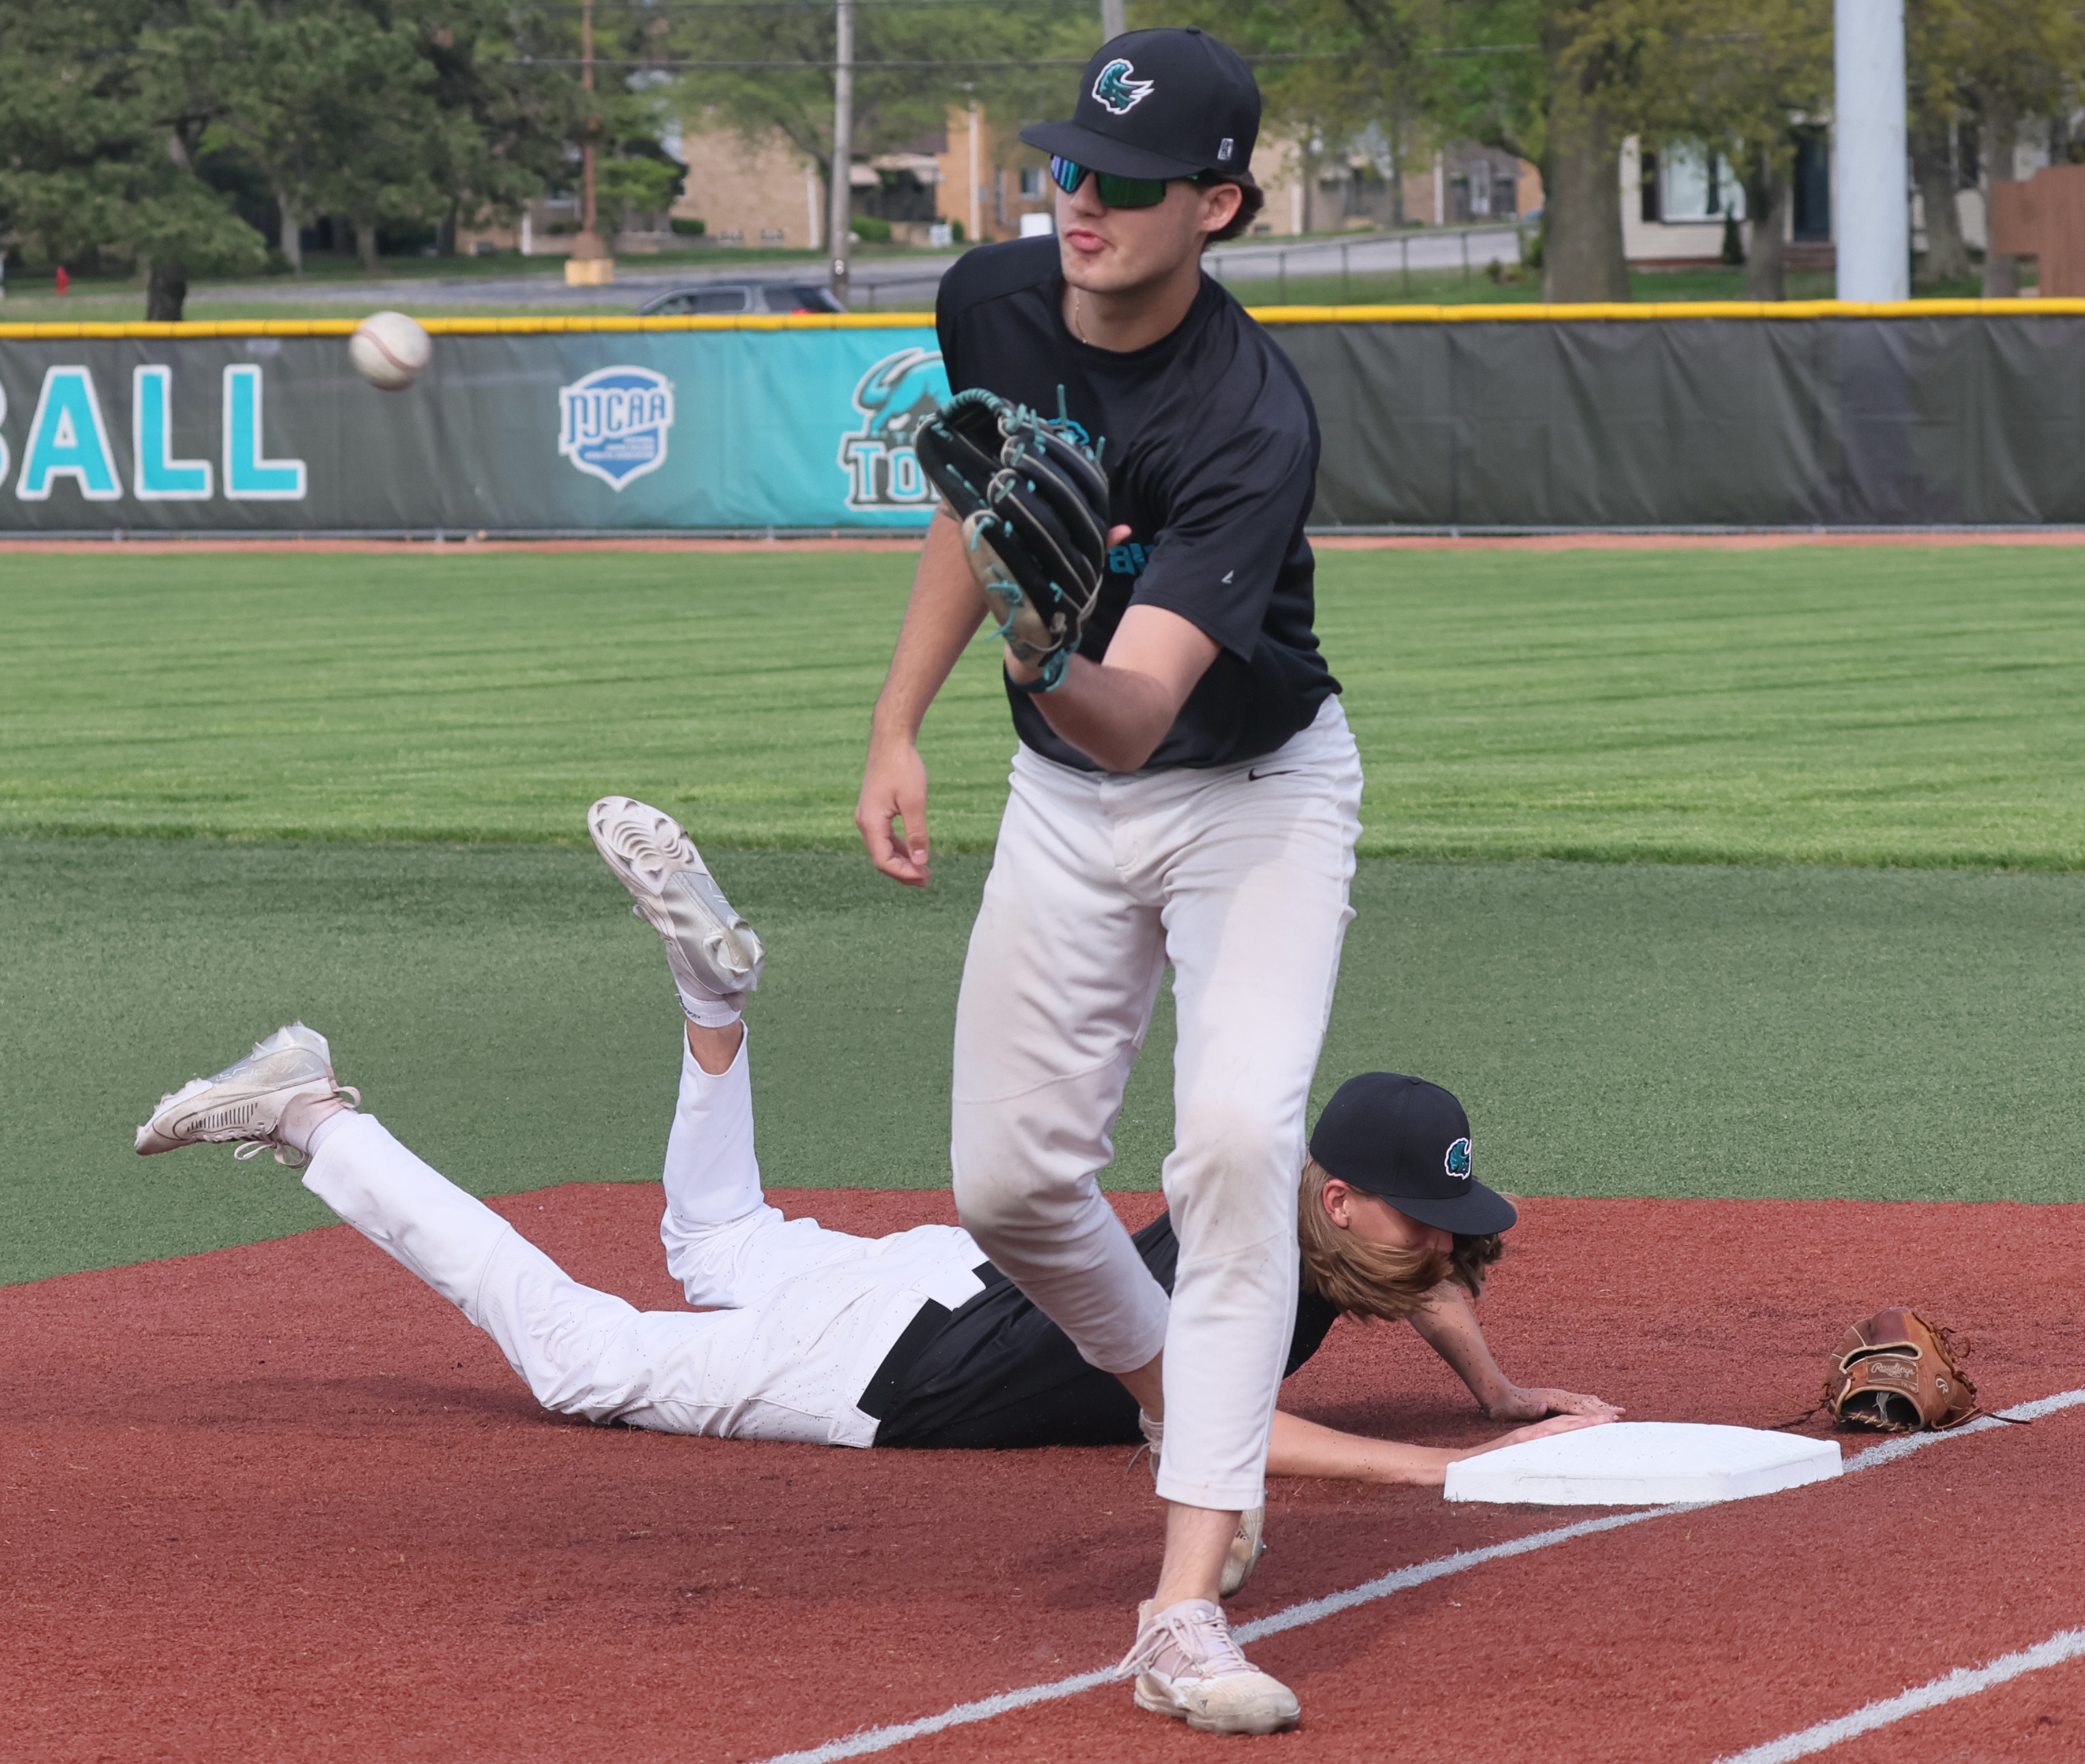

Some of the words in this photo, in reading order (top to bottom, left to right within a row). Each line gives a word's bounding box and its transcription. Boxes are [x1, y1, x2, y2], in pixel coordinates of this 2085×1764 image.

[0, 365, 307, 500] ALL
[567, 392, 666, 445] NJCAA
[848, 441, 944, 502] TO
[1871, 1362, 1915, 1378] Rawlings
